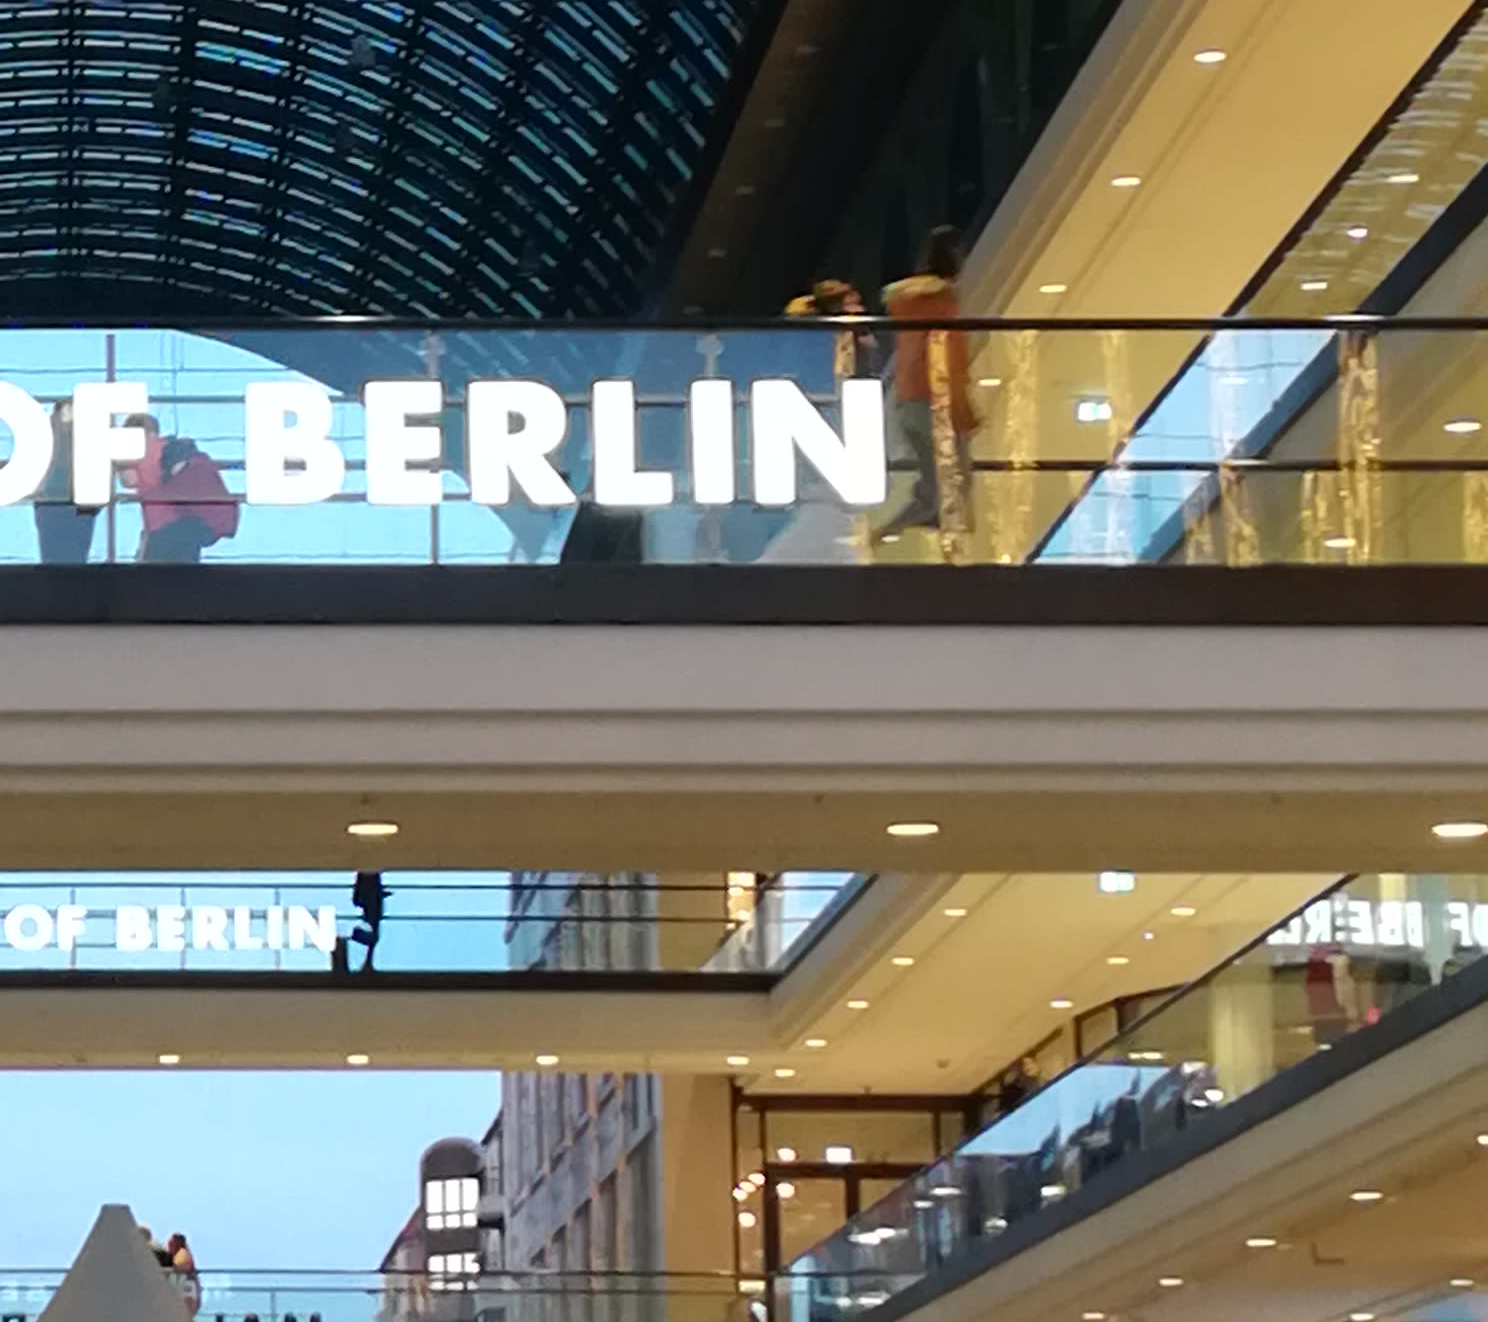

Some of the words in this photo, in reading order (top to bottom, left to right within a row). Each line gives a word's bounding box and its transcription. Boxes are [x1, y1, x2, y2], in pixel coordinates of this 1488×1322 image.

[244, 378, 888, 507] BERLIN
[3, 903, 88, 952] OF
[113, 905, 337, 953] BERLIN
